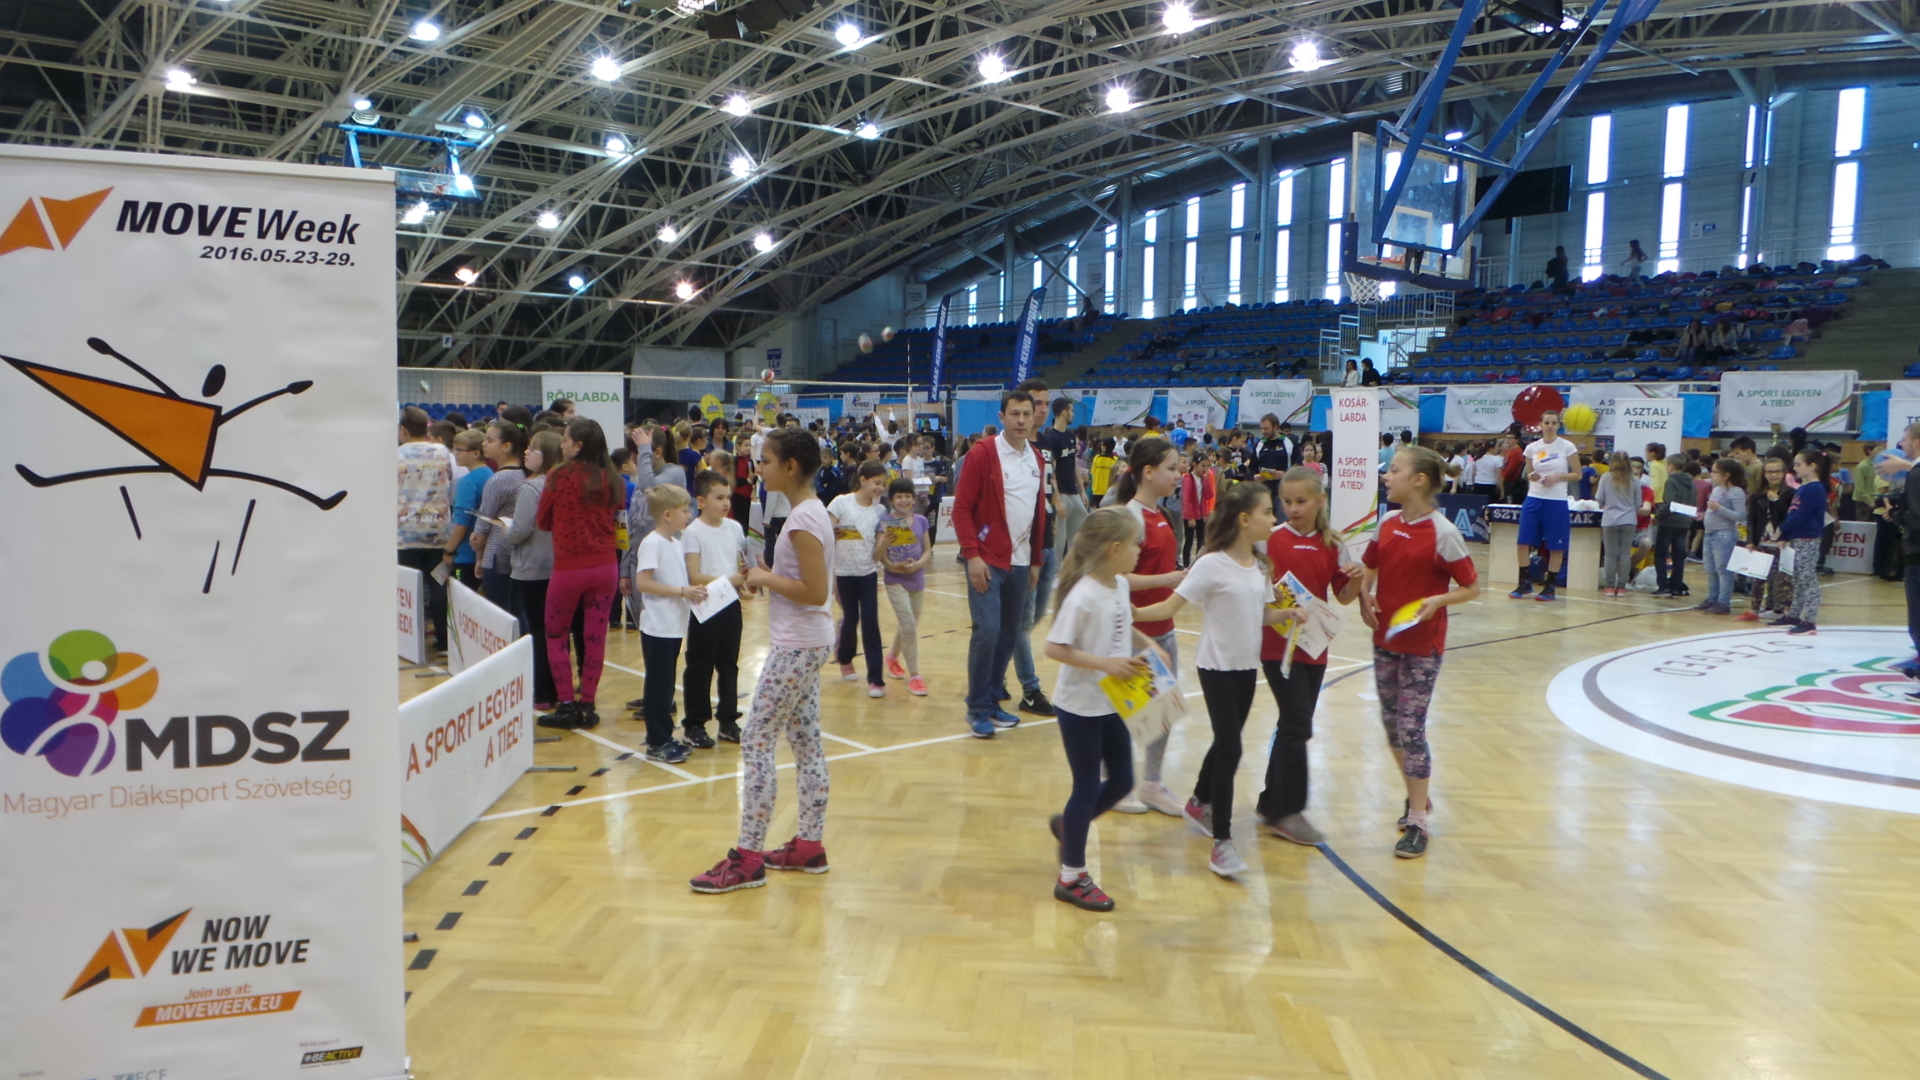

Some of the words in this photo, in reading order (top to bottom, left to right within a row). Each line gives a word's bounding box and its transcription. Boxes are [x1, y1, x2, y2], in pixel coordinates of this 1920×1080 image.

[199, 245, 356, 267] 2016.05.23-29.
[1025, 296, 1039, 334] SPORT
[547, 389, 620, 403] RÖPLABDA
[1737, 390, 1744, 398] A
[1747, 390, 1778, 398] SPORT
[1781, 389, 1822, 397] LEGYEN
[1339, 396, 1369, 408] KOSÁR-
[1340, 412, 1367, 422] LABDA
[1624, 407, 1673, 416] ASZTALI-
[1628, 420, 1667, 429] TENISZ
[1337, 457, 1343, 465] A
[1344, 457, 1367, 467] SPORT
[1338, 469, 1366, 478] LEGYEN
[1340, 481, 1345, 489] A
[1346, 481, 1365, 490] TIED!
[1833, 546, 1864, 558] IED!
[406, 742, 420, 781] A
[425, 705, 475, 768] SPORT
[478, 672, 524, 732] LEGYEN
[126, 710, 351, 772] MDSZ
[484, 736, 494, 768] A
[497, 711, 523, 758] TIED!
[4, 792, 103, 820] Magyar
[110, 782, 229, 809] Diáksport
[235, 774, 353, 801] Szövetség
[201, 914, 271, 944] NOW
[171, 946, 217, 976] WE
[224, 938, 311, 971] MOVE
[184, 988, 213, 1000] Join
[216, 986, 232, 997] us
[235, 983, 252, 995] at:
[154, 995, 282, 1022] MOVEWEEK.EU
